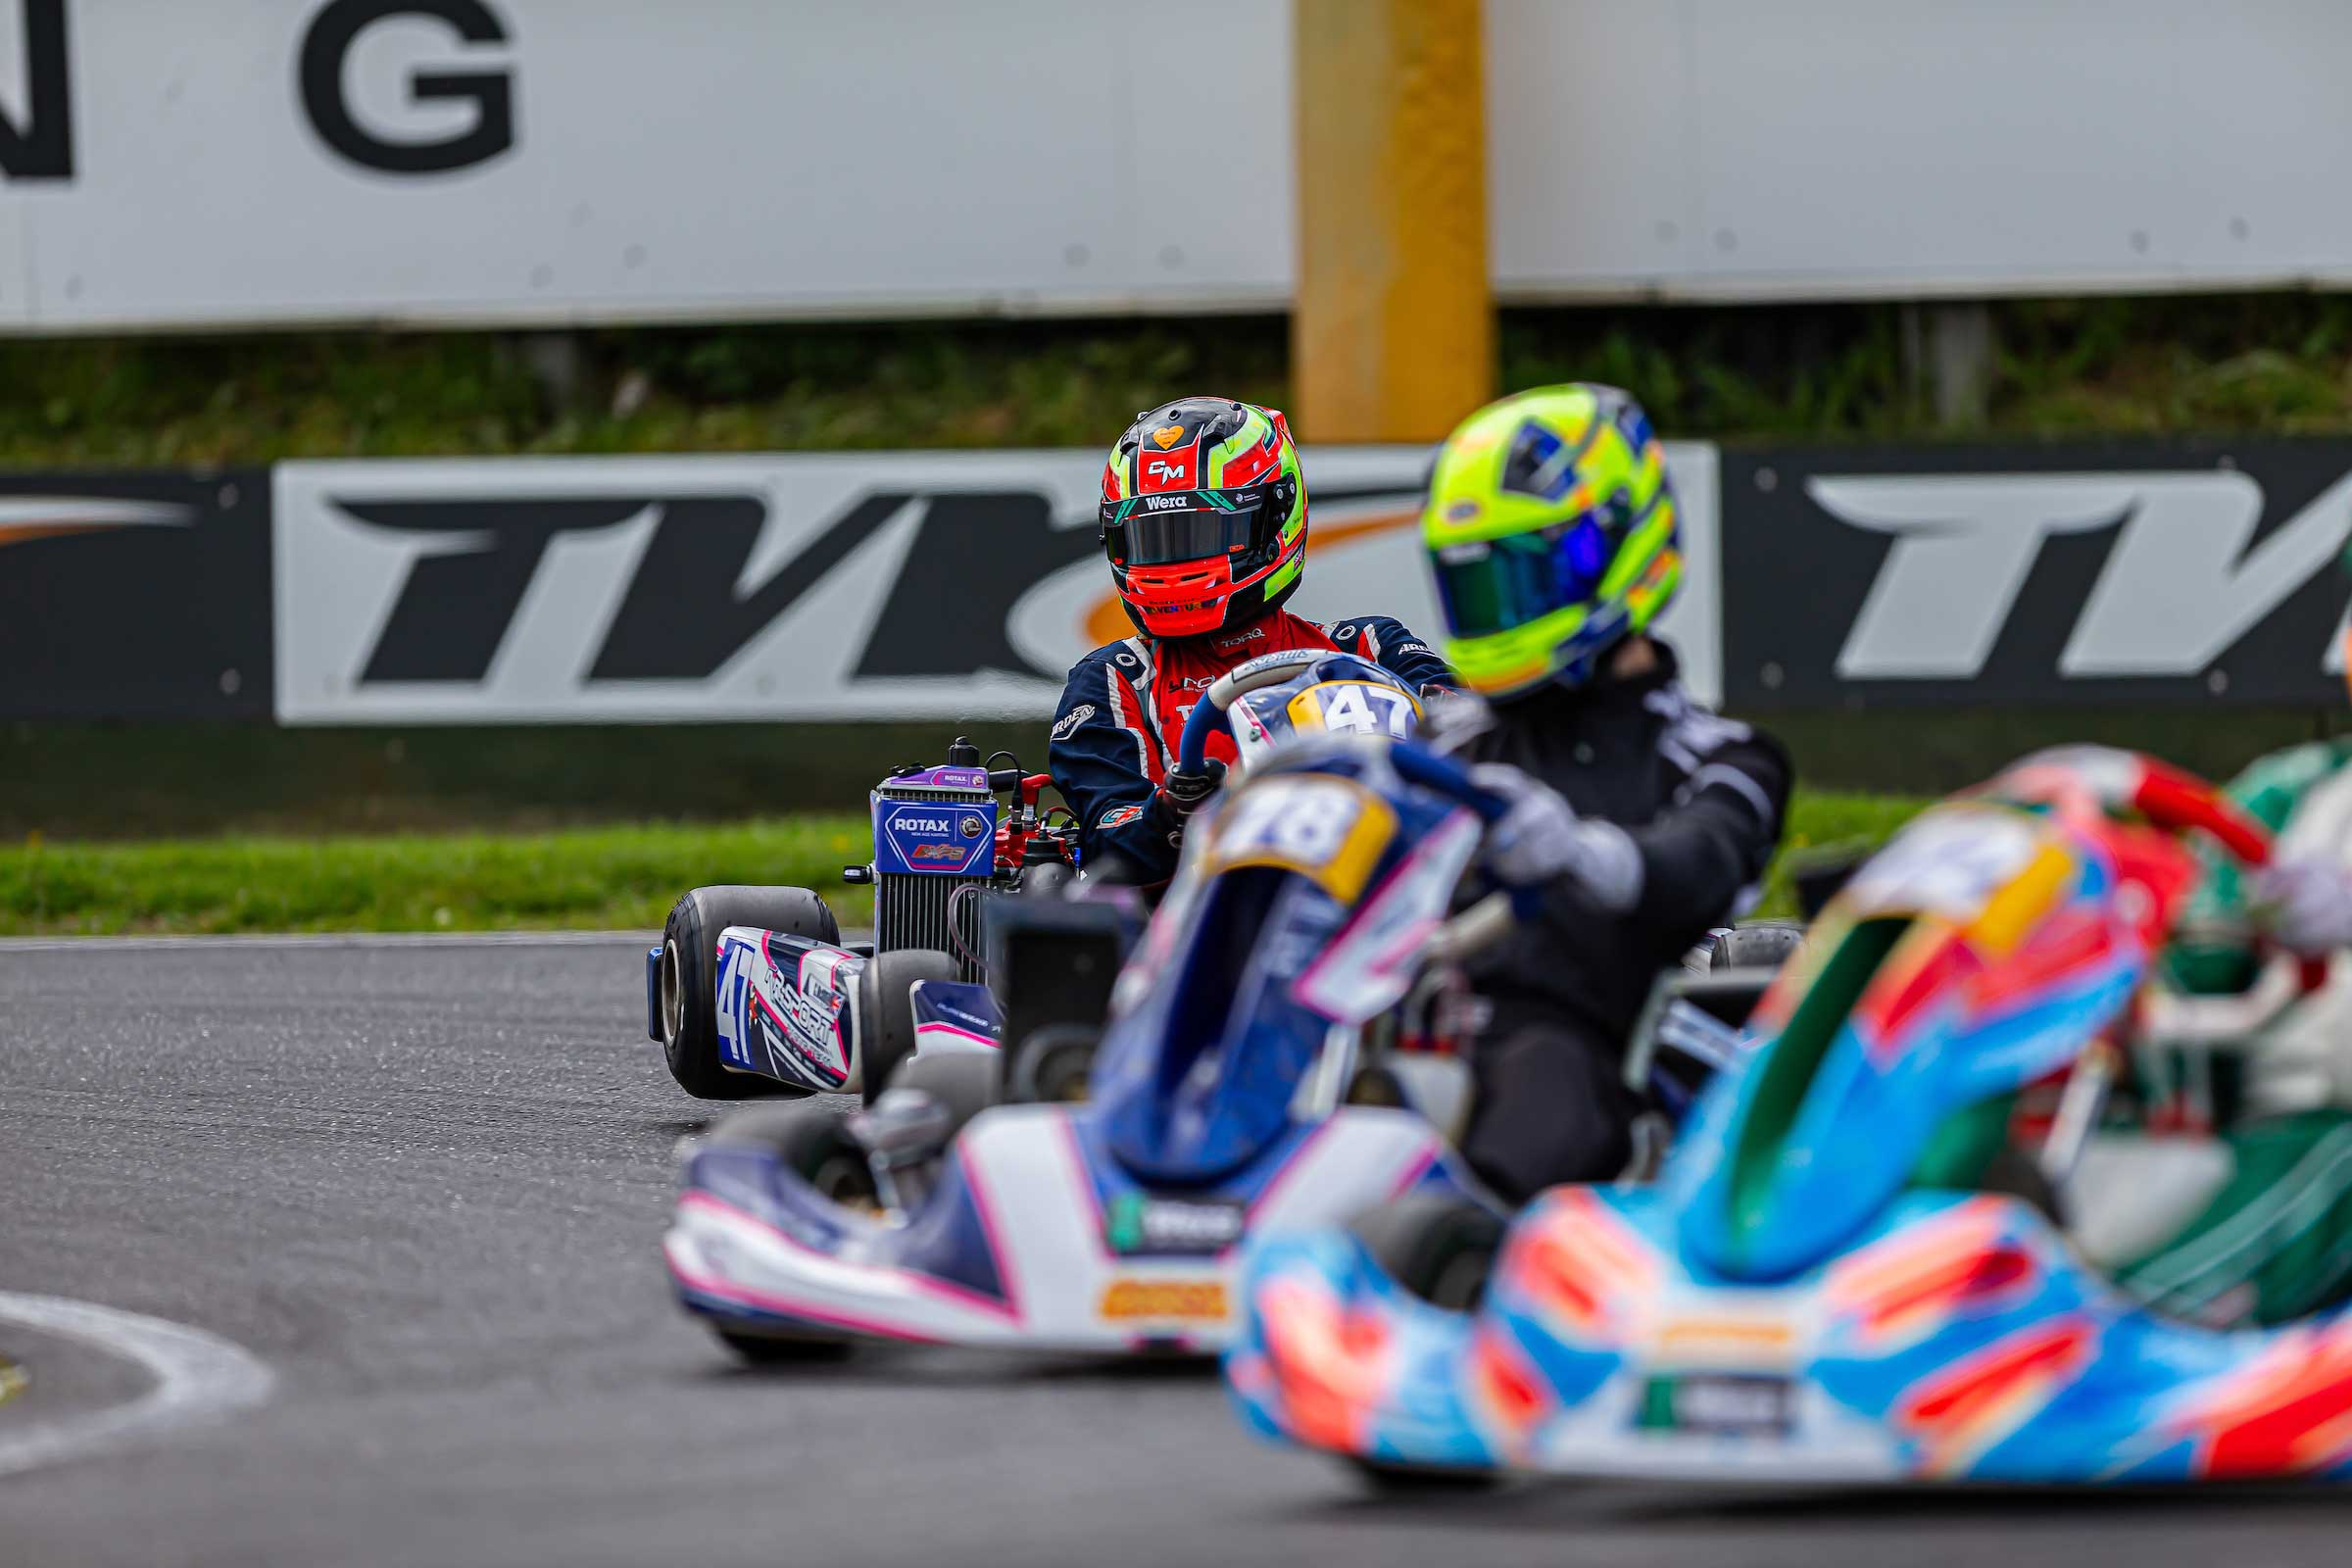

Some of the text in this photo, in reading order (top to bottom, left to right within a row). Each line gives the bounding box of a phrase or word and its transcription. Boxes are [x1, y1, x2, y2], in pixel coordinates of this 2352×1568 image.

[1146, 495, 1188, 511] Wera
[1806, 470, 2352, 678] TV
[1324, 684, 1413, 741] 47
[944, 774, 967, 783] ROTAX
[895, 818, 949, 832] ROTAX
[717, 944, 756, 1064] 47
